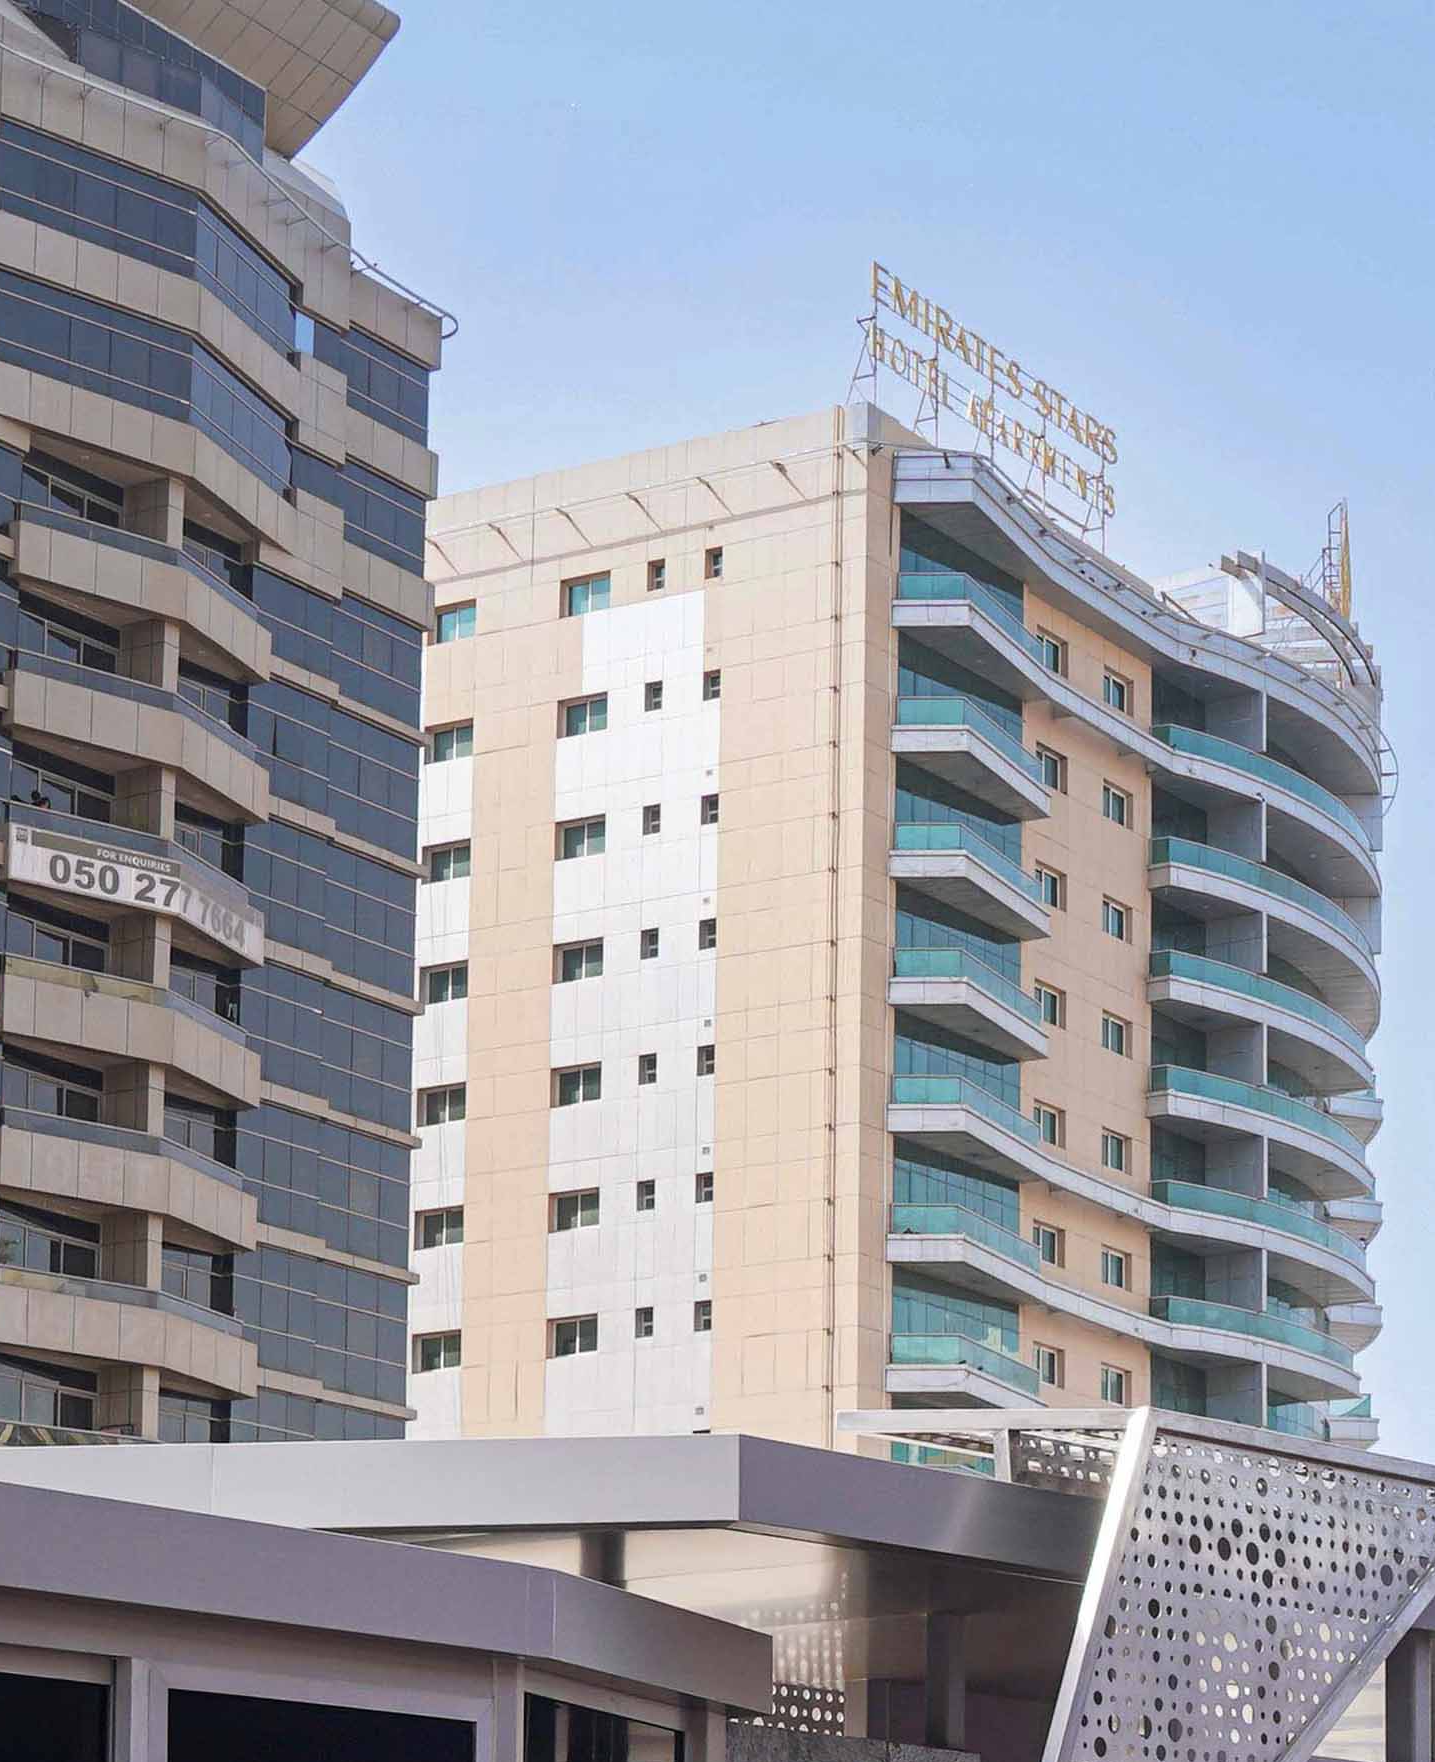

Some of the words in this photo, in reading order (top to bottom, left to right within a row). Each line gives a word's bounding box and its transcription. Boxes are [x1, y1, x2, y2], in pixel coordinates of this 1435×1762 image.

[869, 260, 1024, 401] EMIRATES
[867, 320, 949, 408] HOTEL
[965, 386, 1116, 519] APARTMENTS
[49, 854, 120, 896] 050
[96, 848, 117, 862] FOR
[118, 852, 172, 874] ENQUIRIES
